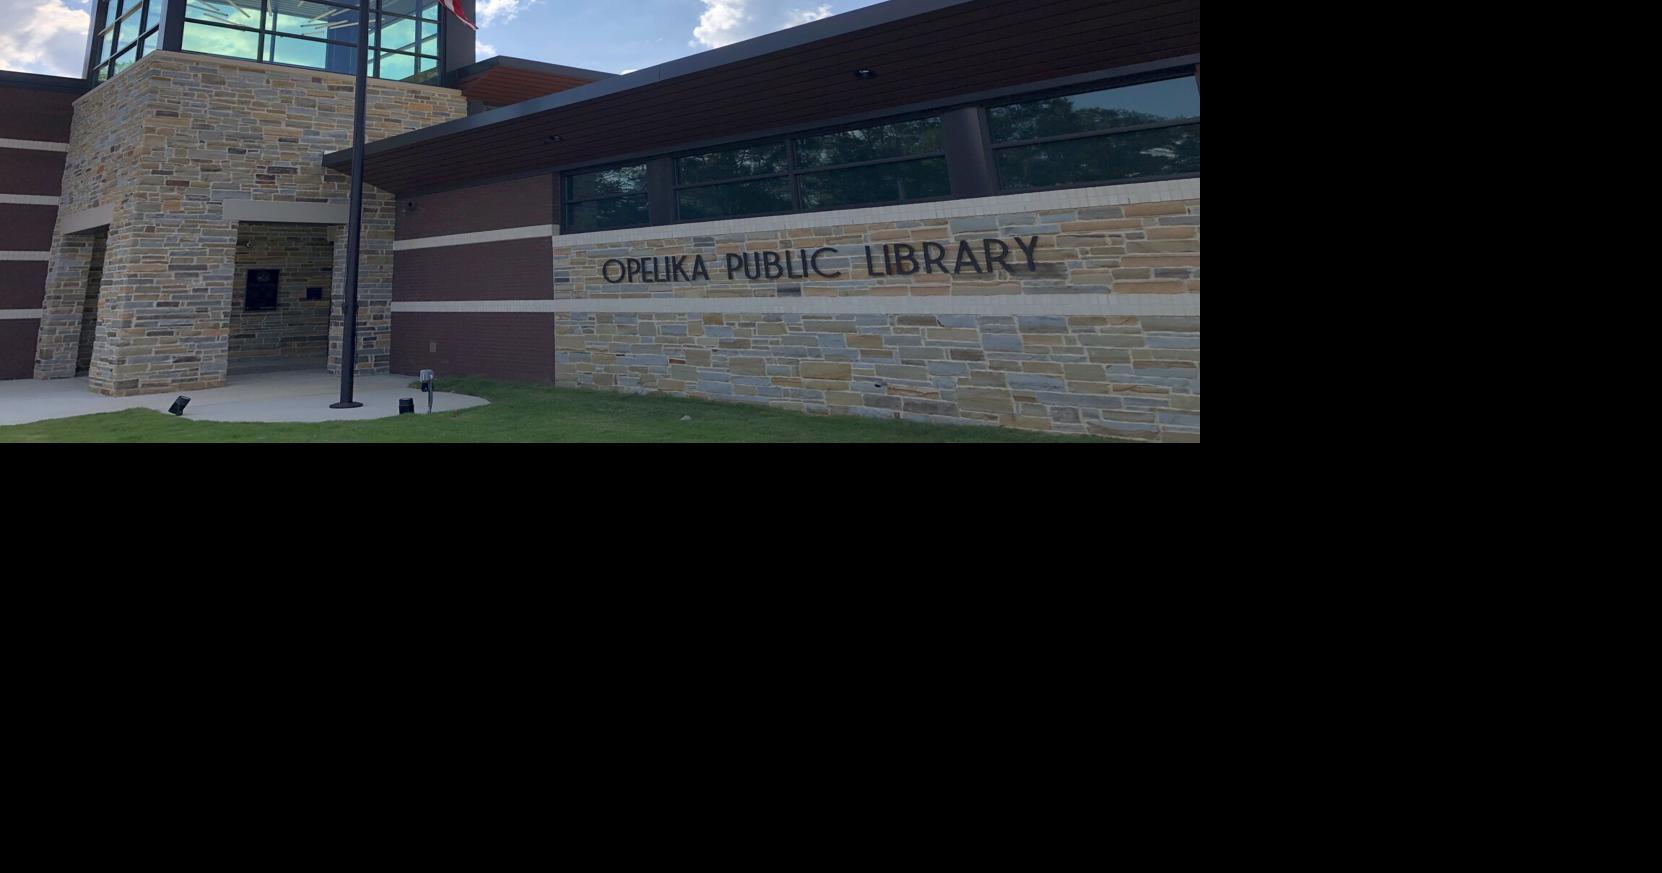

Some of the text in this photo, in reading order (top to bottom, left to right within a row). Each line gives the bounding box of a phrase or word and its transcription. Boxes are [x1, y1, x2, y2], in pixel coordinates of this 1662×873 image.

[602, 235, 1039, 283] OPELIKA PUBLIC LIBRARY
